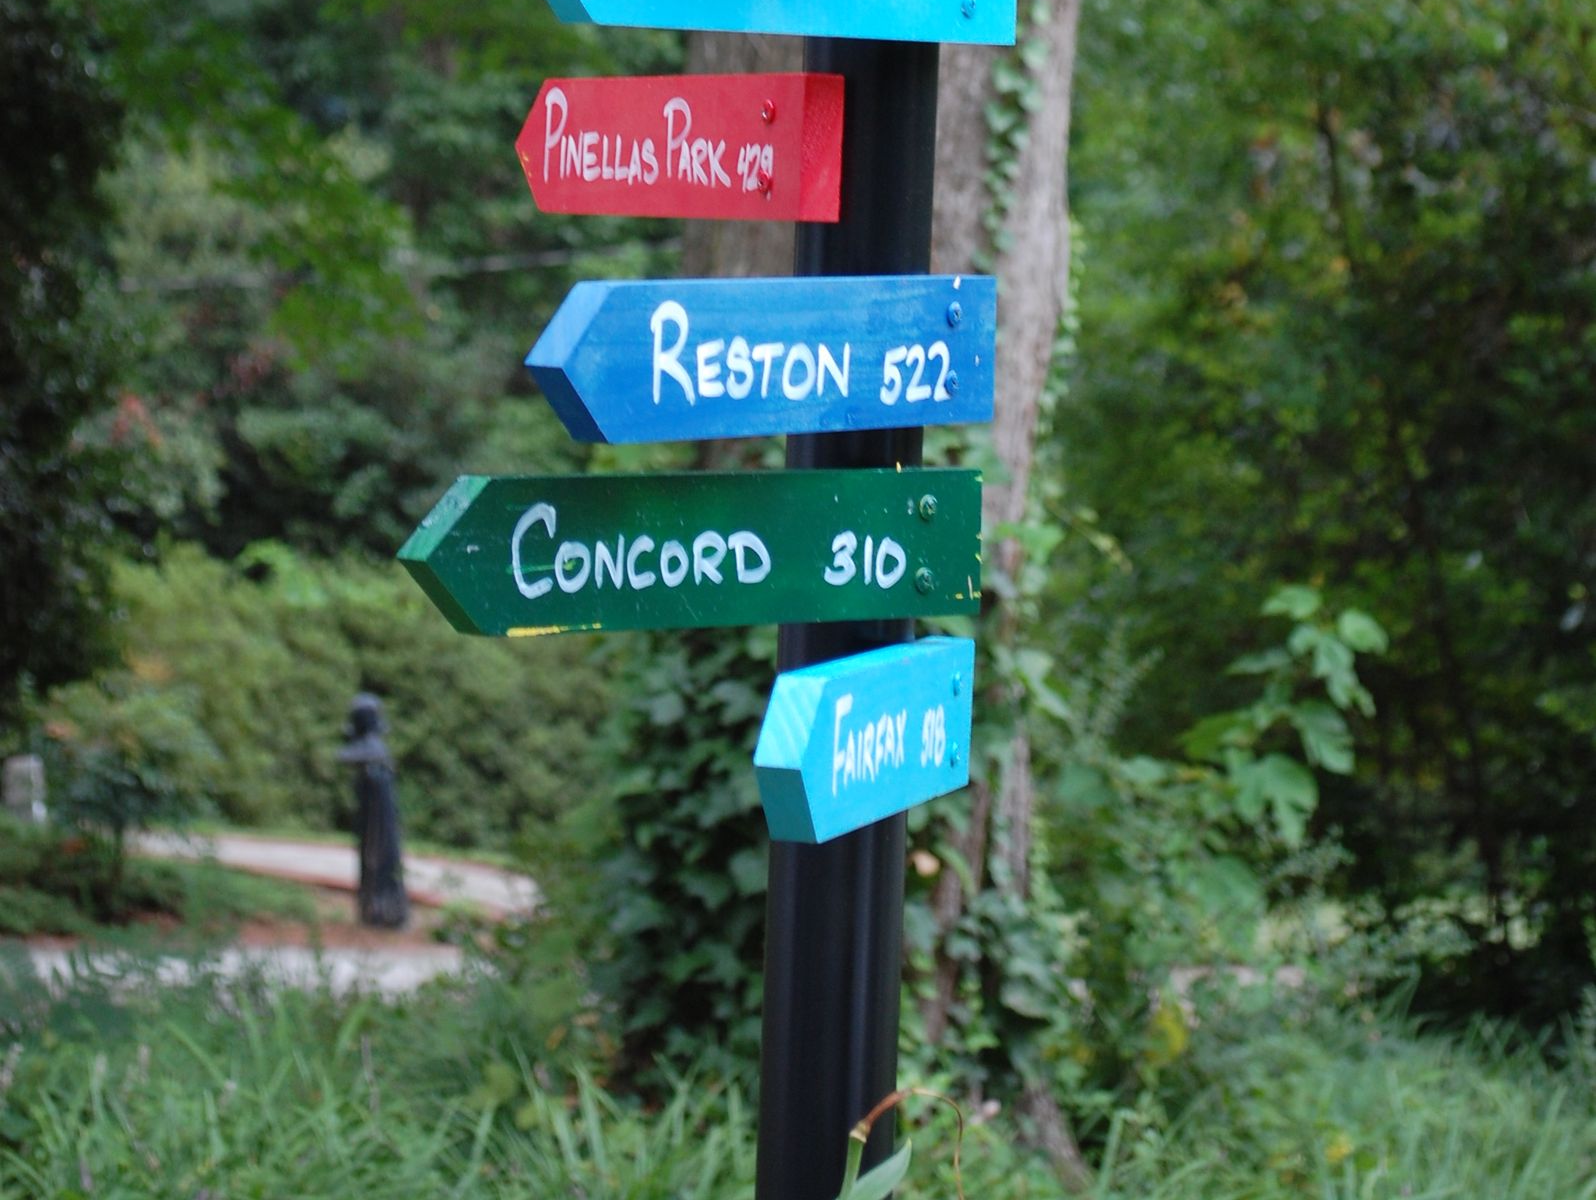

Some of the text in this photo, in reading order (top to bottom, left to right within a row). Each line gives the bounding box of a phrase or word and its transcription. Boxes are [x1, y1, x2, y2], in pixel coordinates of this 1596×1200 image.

[543, 86, 659, 185] PINELLAS
[663, 97, 731, 188] PARK
[650, 300, 952, 406] RESTON 522
[512, 502, 907, 599] CONCORD 310
[831, 692, 947, 798] FAIRFAX 518
